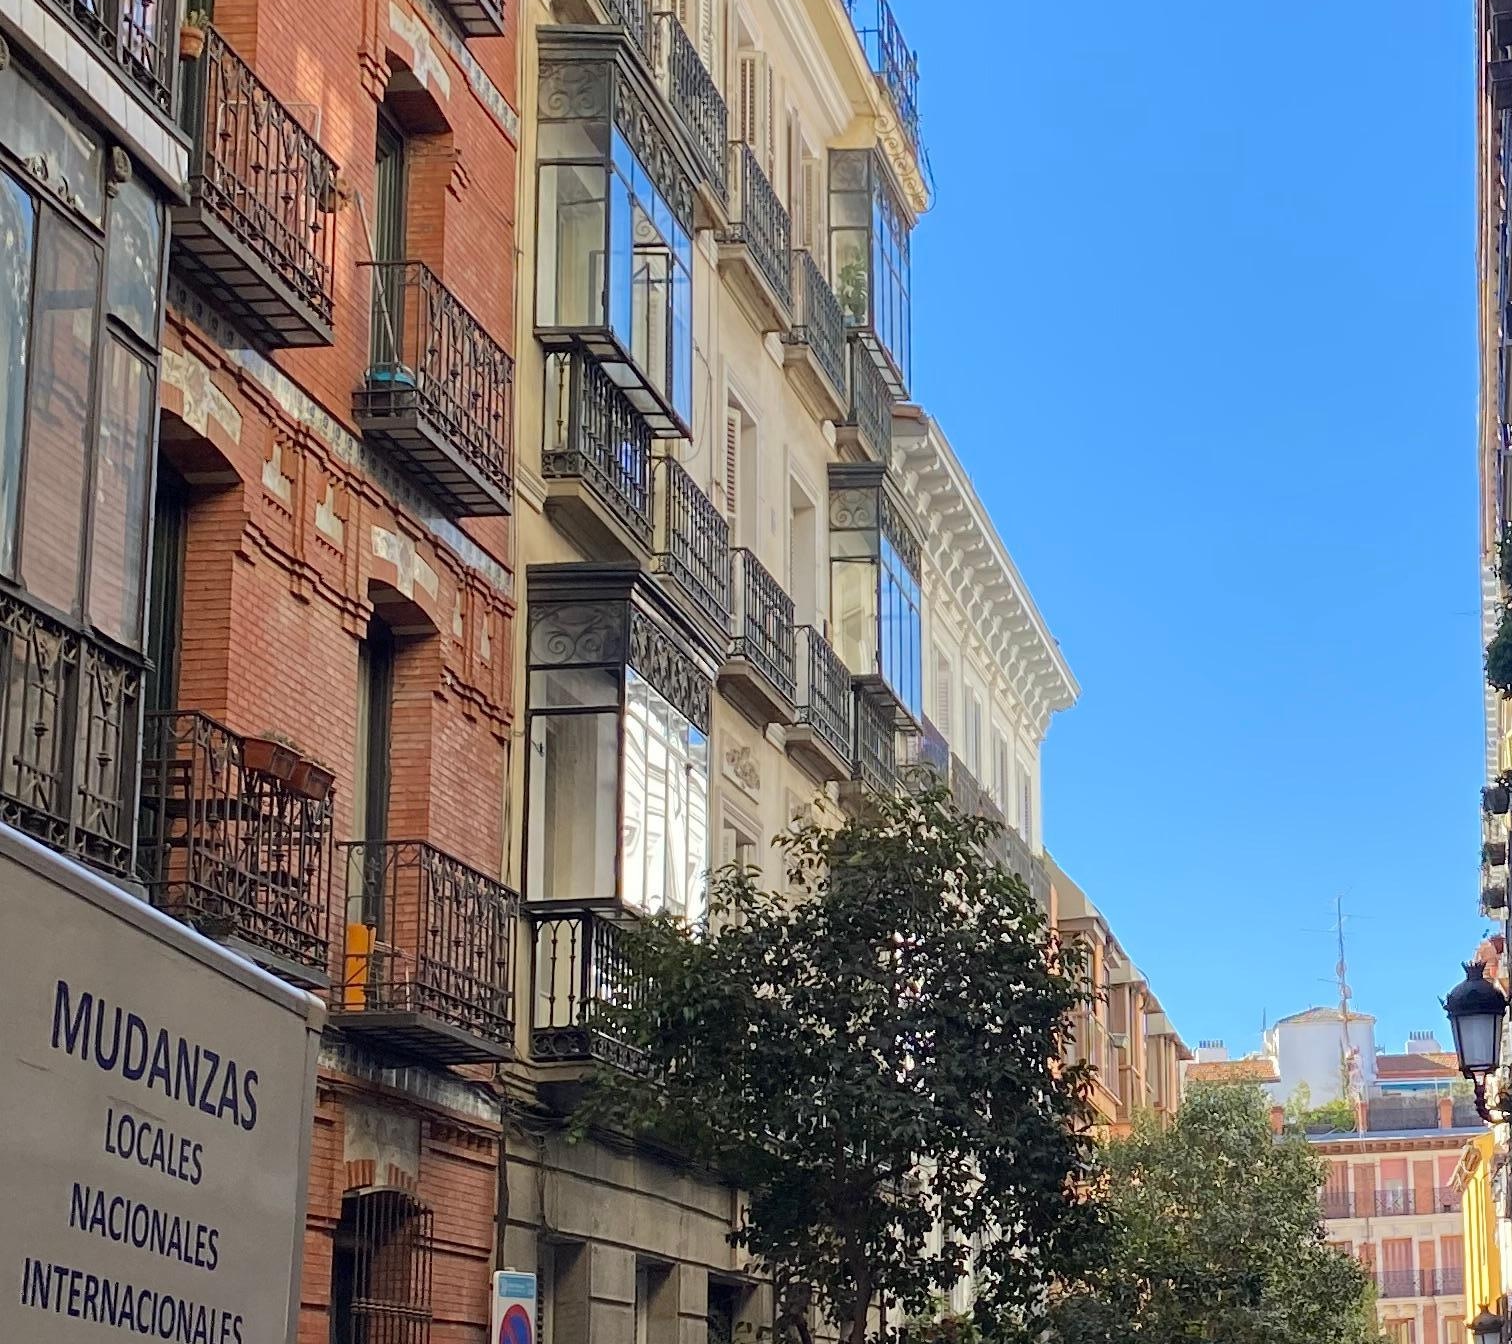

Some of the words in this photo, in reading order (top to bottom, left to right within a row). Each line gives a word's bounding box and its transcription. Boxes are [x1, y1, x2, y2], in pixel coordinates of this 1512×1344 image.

[51, 980, 258, 1131] MUDANZAS
[105, 1109, 203, 1185] LOCALES
[69, 1182, 219, 1271] NACIONALES
